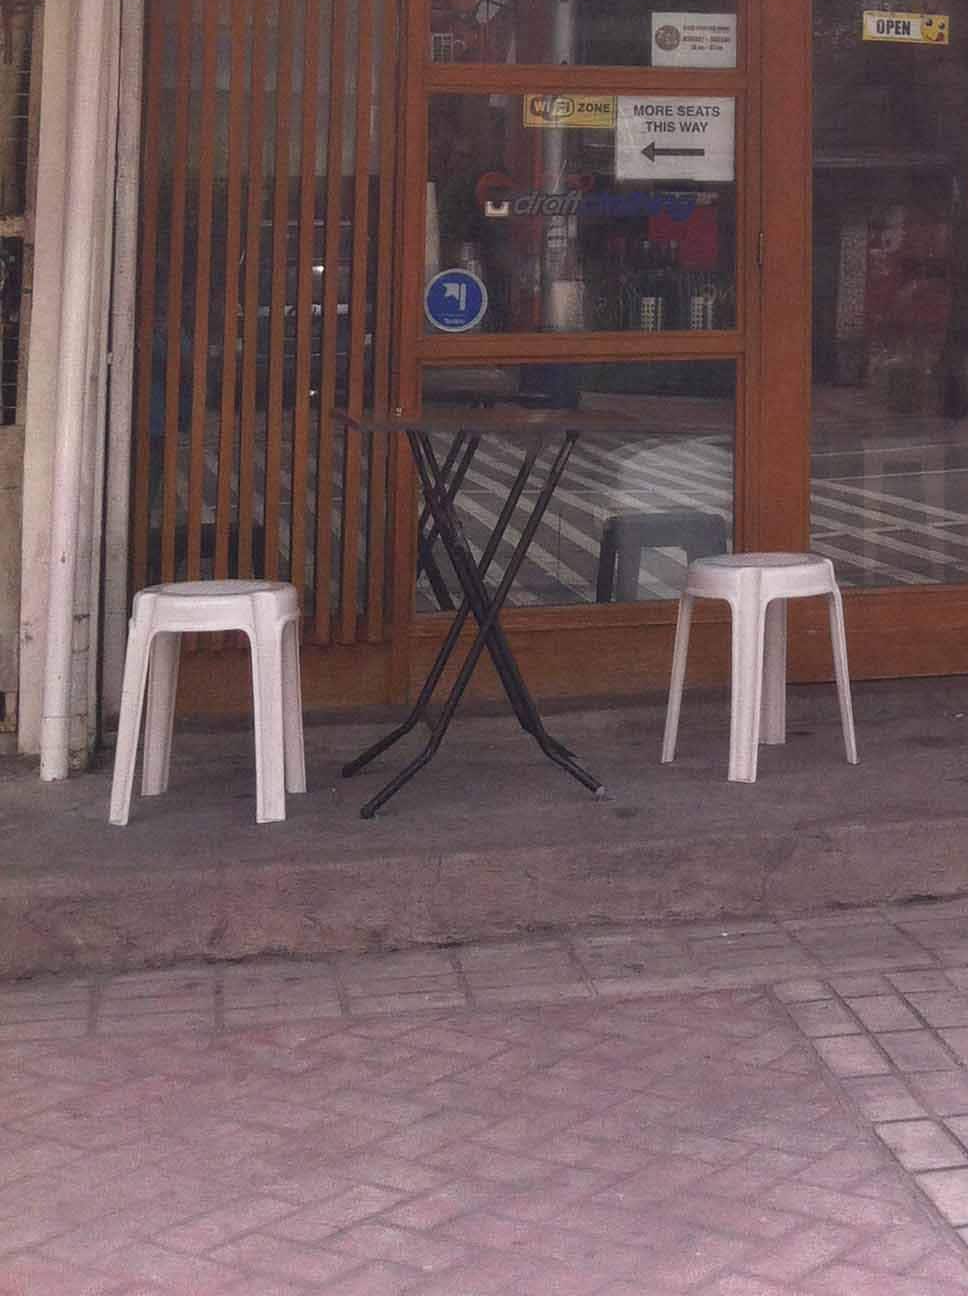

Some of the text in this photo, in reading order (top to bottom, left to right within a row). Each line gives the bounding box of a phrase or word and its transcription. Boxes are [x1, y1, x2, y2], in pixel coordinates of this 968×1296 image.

[876, 19, 911, 36] OPEN
[577, 103, 610, 113] ZONE
[633, 104, 721, 118] MORE SEATS
[645, 121, 709, 133] THIS WAY
